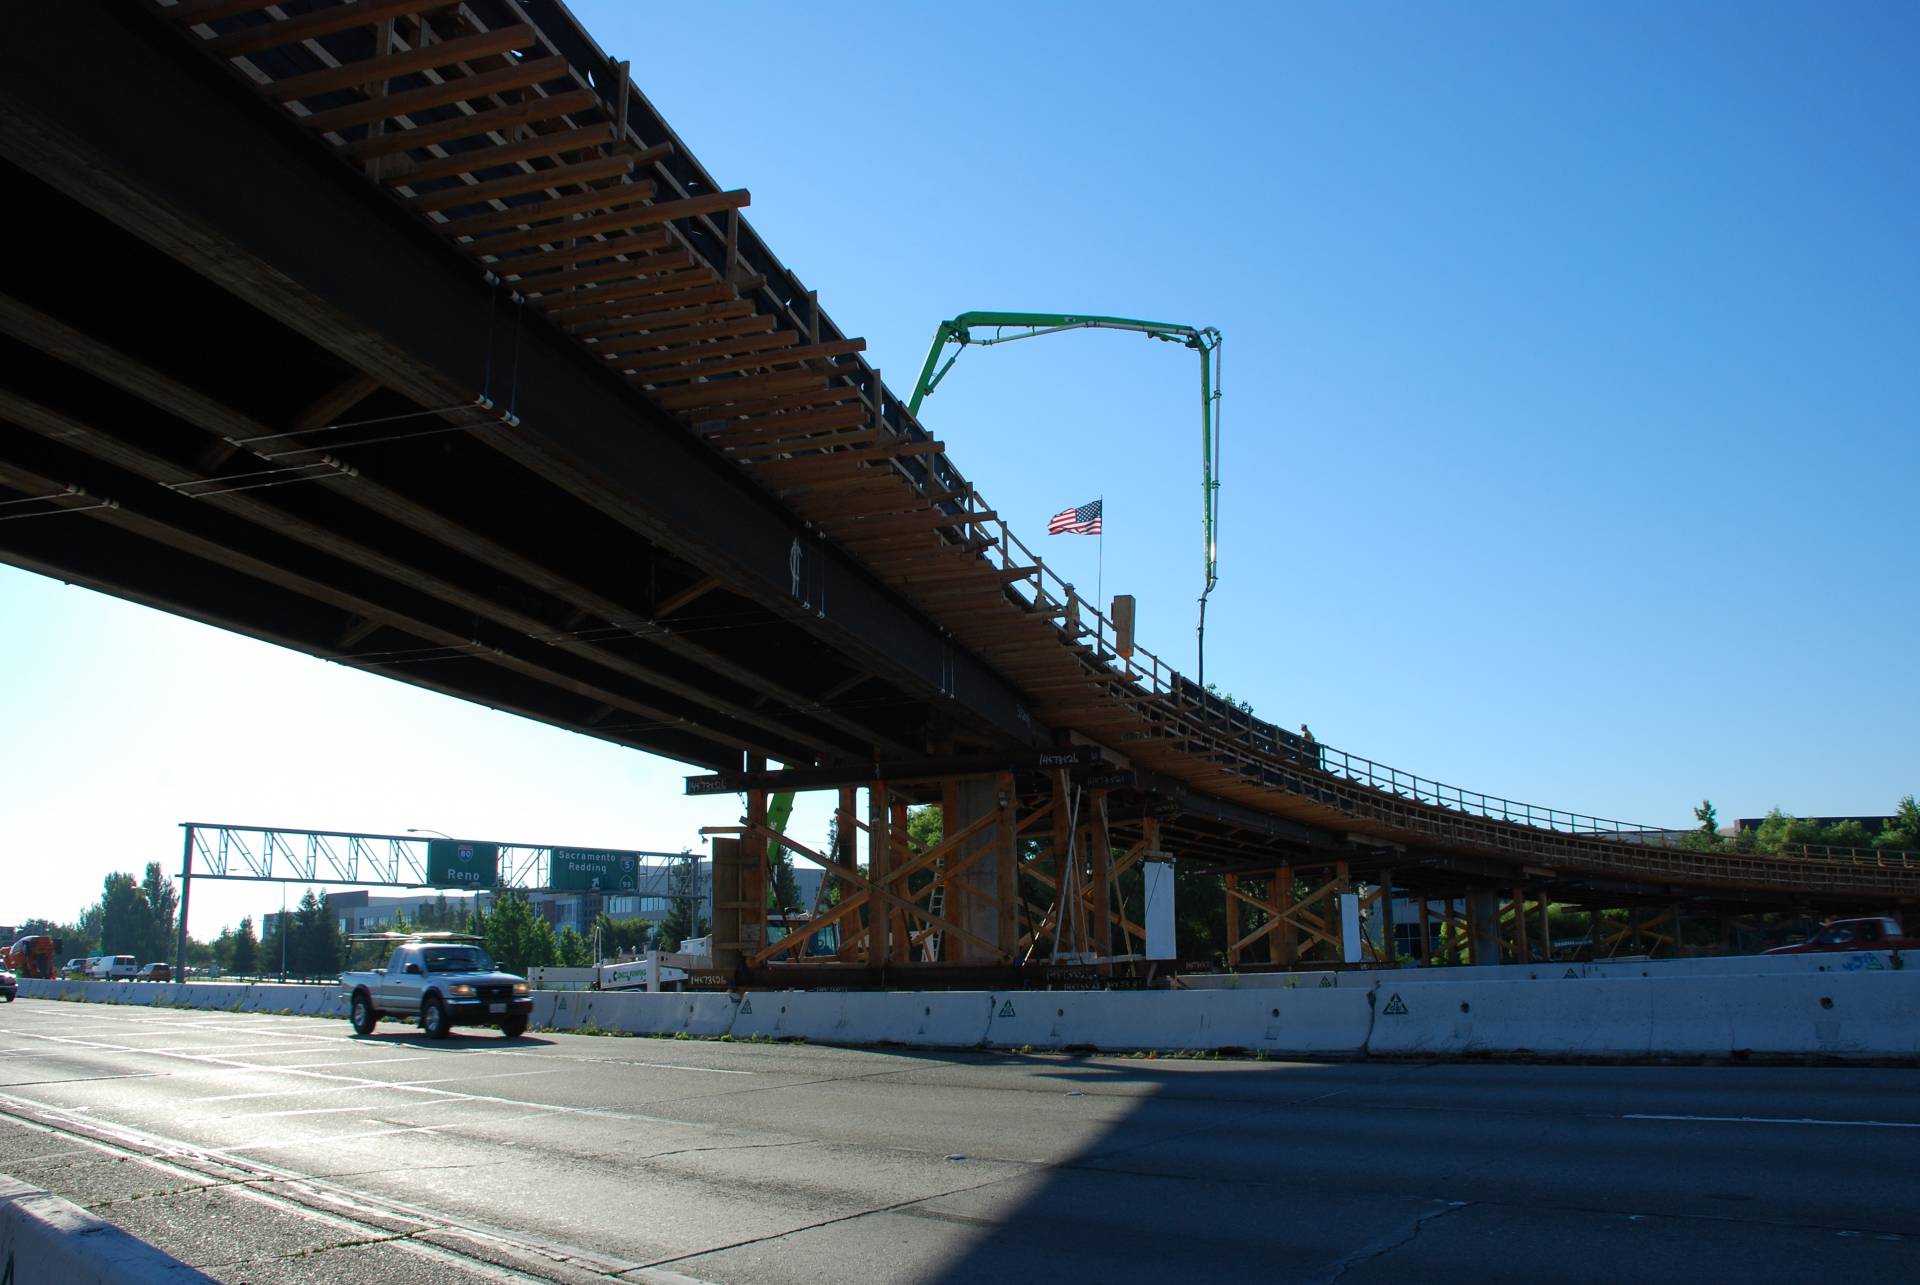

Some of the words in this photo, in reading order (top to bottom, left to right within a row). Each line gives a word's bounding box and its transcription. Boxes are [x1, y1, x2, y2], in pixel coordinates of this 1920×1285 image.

[558, 850, 616, 862] Sacramento
[568, 862, 607, 875] Redding
[624, 861, 631, 869] 5
[447, 869, 480, 881] Reno
